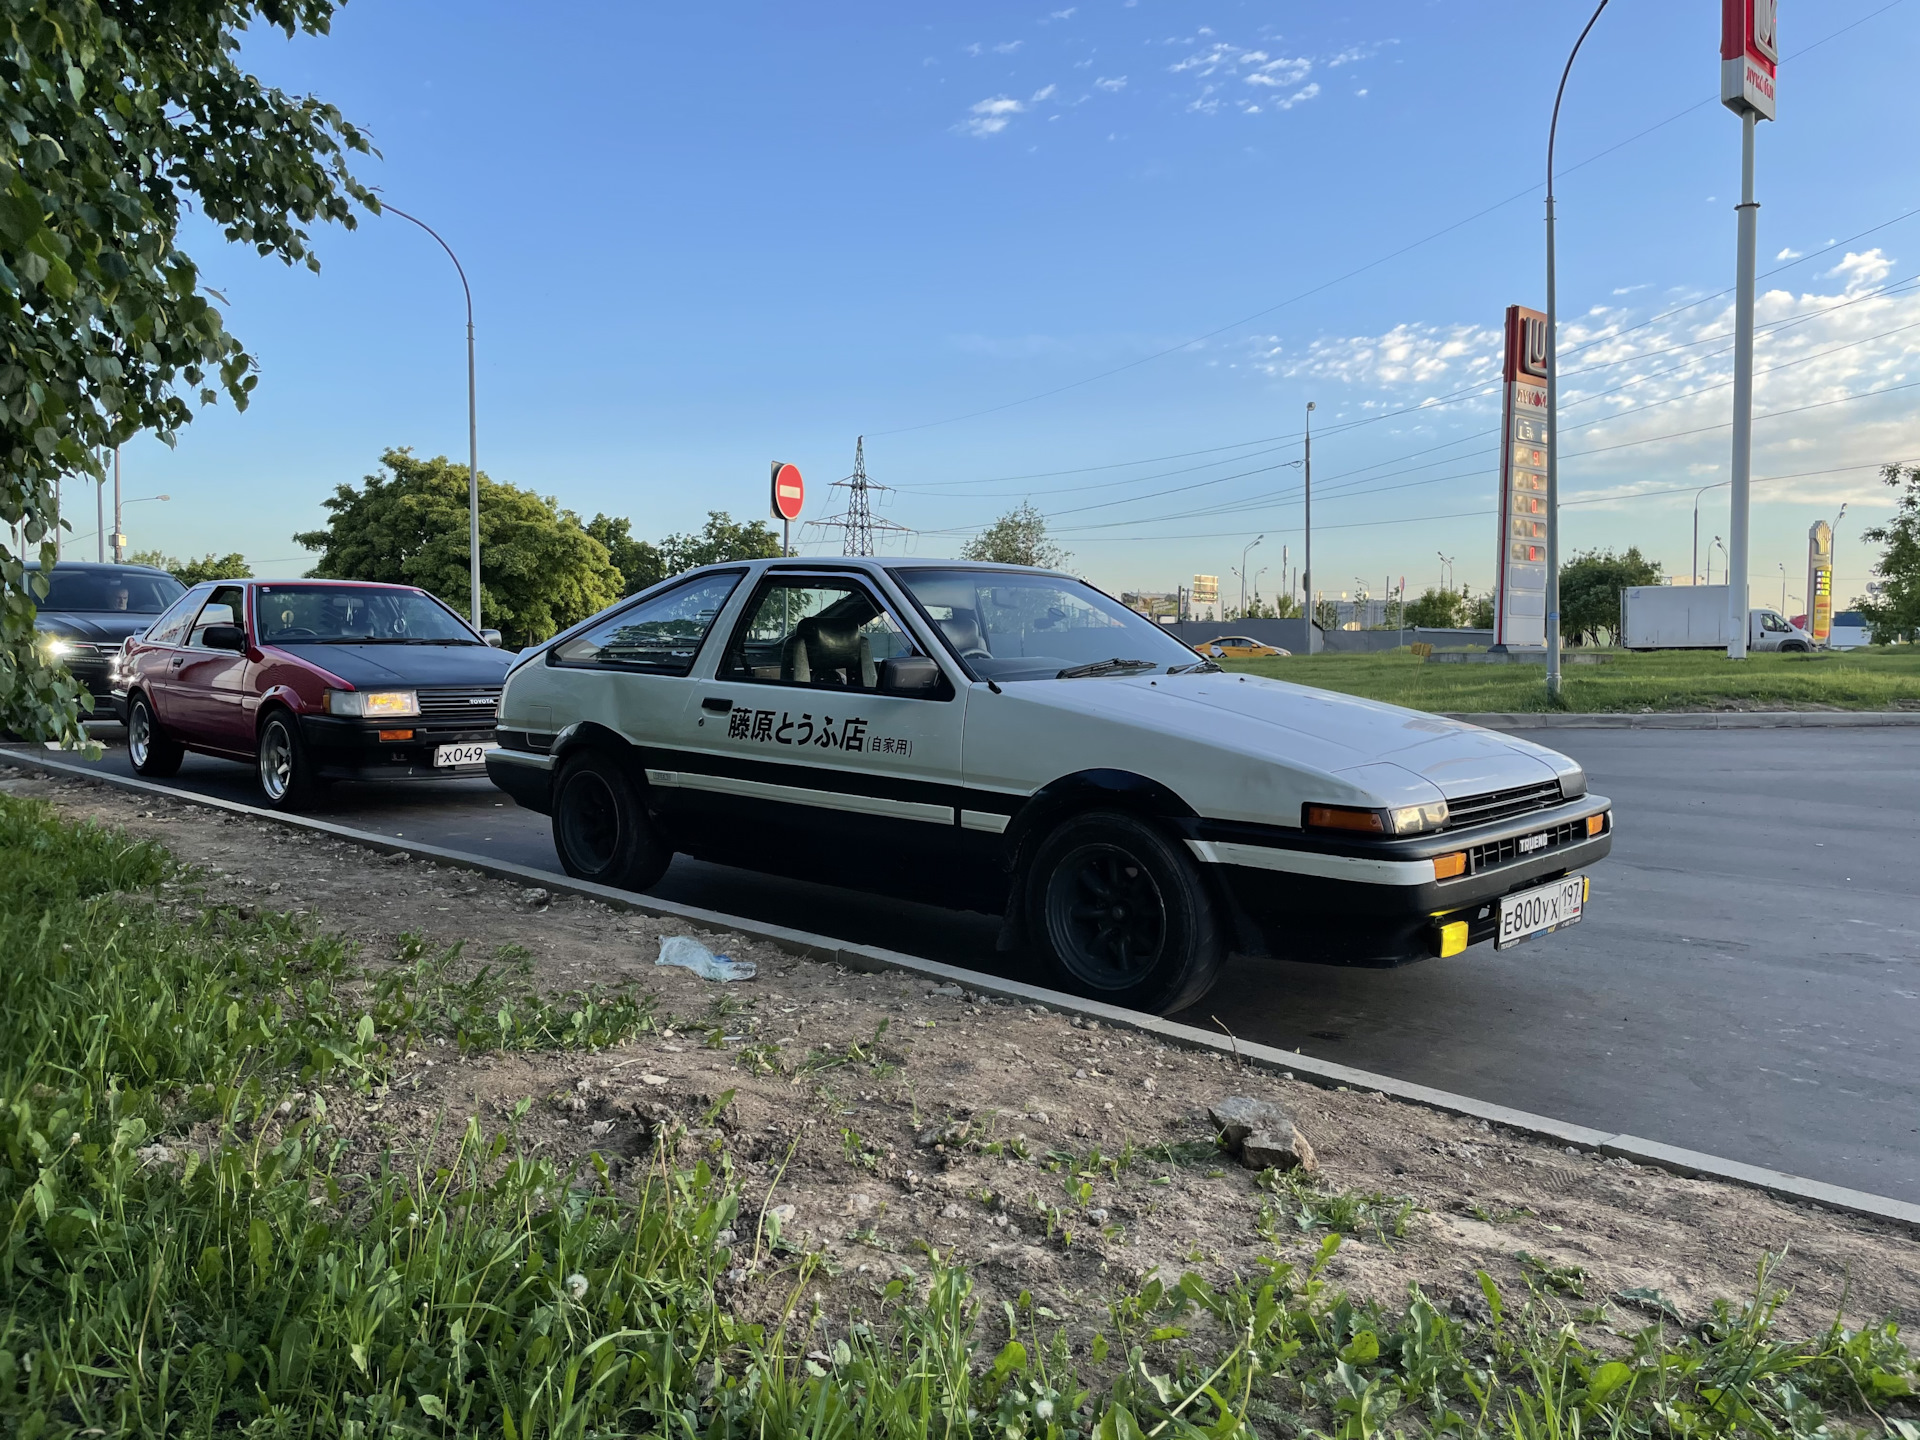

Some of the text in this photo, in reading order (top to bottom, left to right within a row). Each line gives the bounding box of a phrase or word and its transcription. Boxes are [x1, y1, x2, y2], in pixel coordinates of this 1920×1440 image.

[1516, 388, 1548, 408] ЛУКОЙ
[443, 747, 483, 763] Х049
[1519, 833, 1548, 853] TRUENO
[1562, 881, 1580, 907] 197
